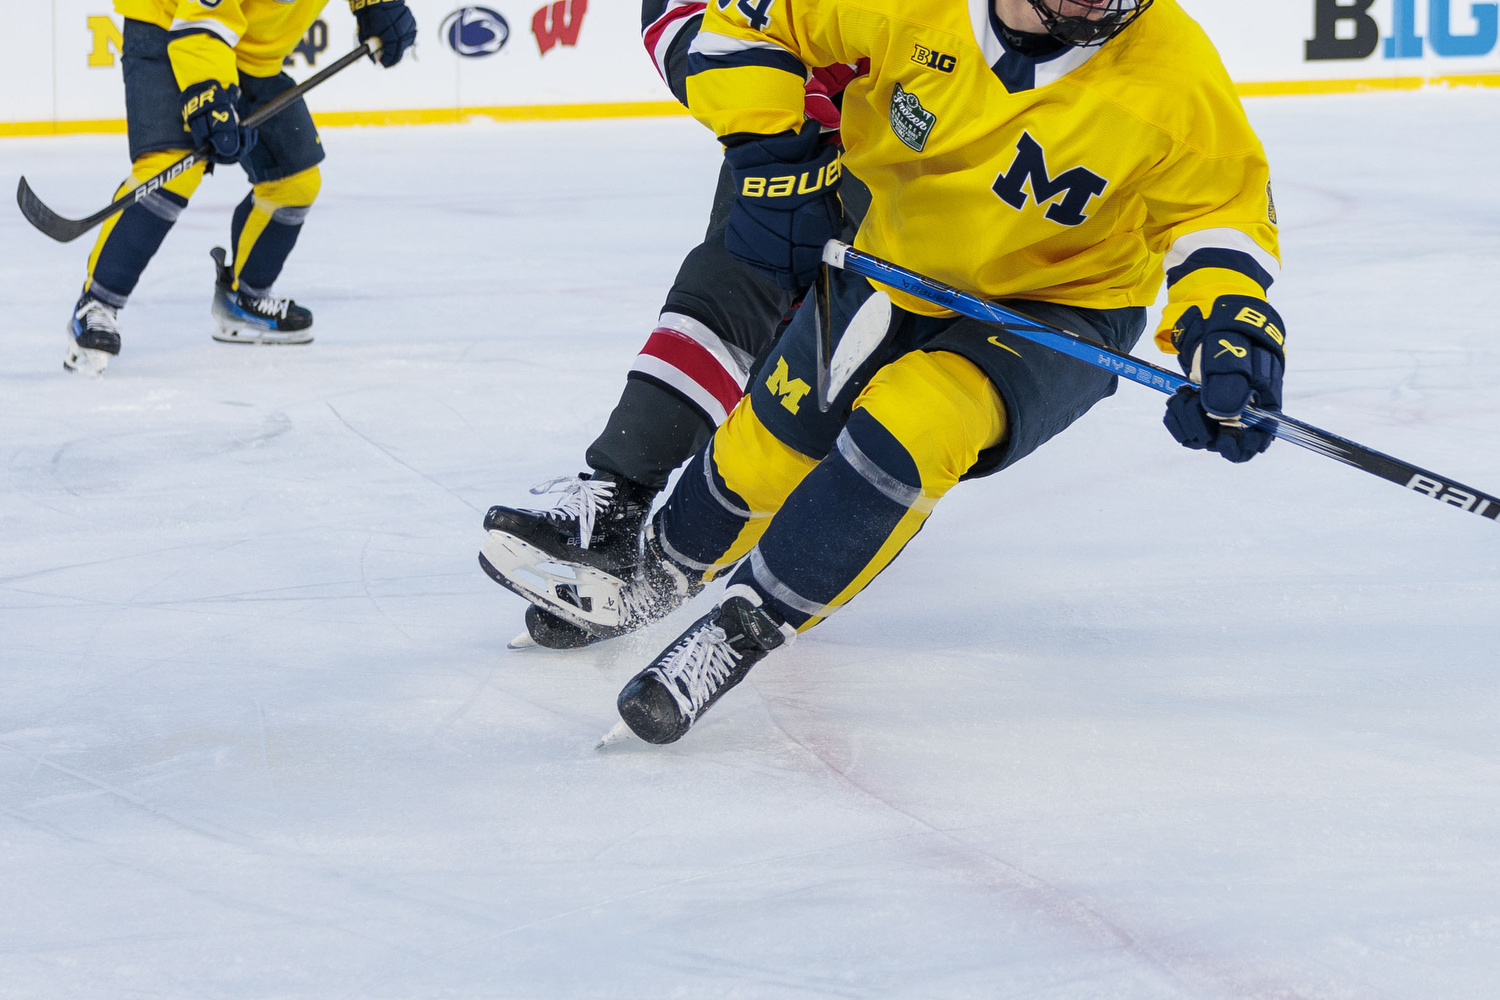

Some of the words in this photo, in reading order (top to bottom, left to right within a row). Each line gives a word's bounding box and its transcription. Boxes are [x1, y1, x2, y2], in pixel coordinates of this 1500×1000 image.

[992, 130, 1108, 227] M
[765, 355, 812, 416] M
[567, 534, 606, 546] BAER
